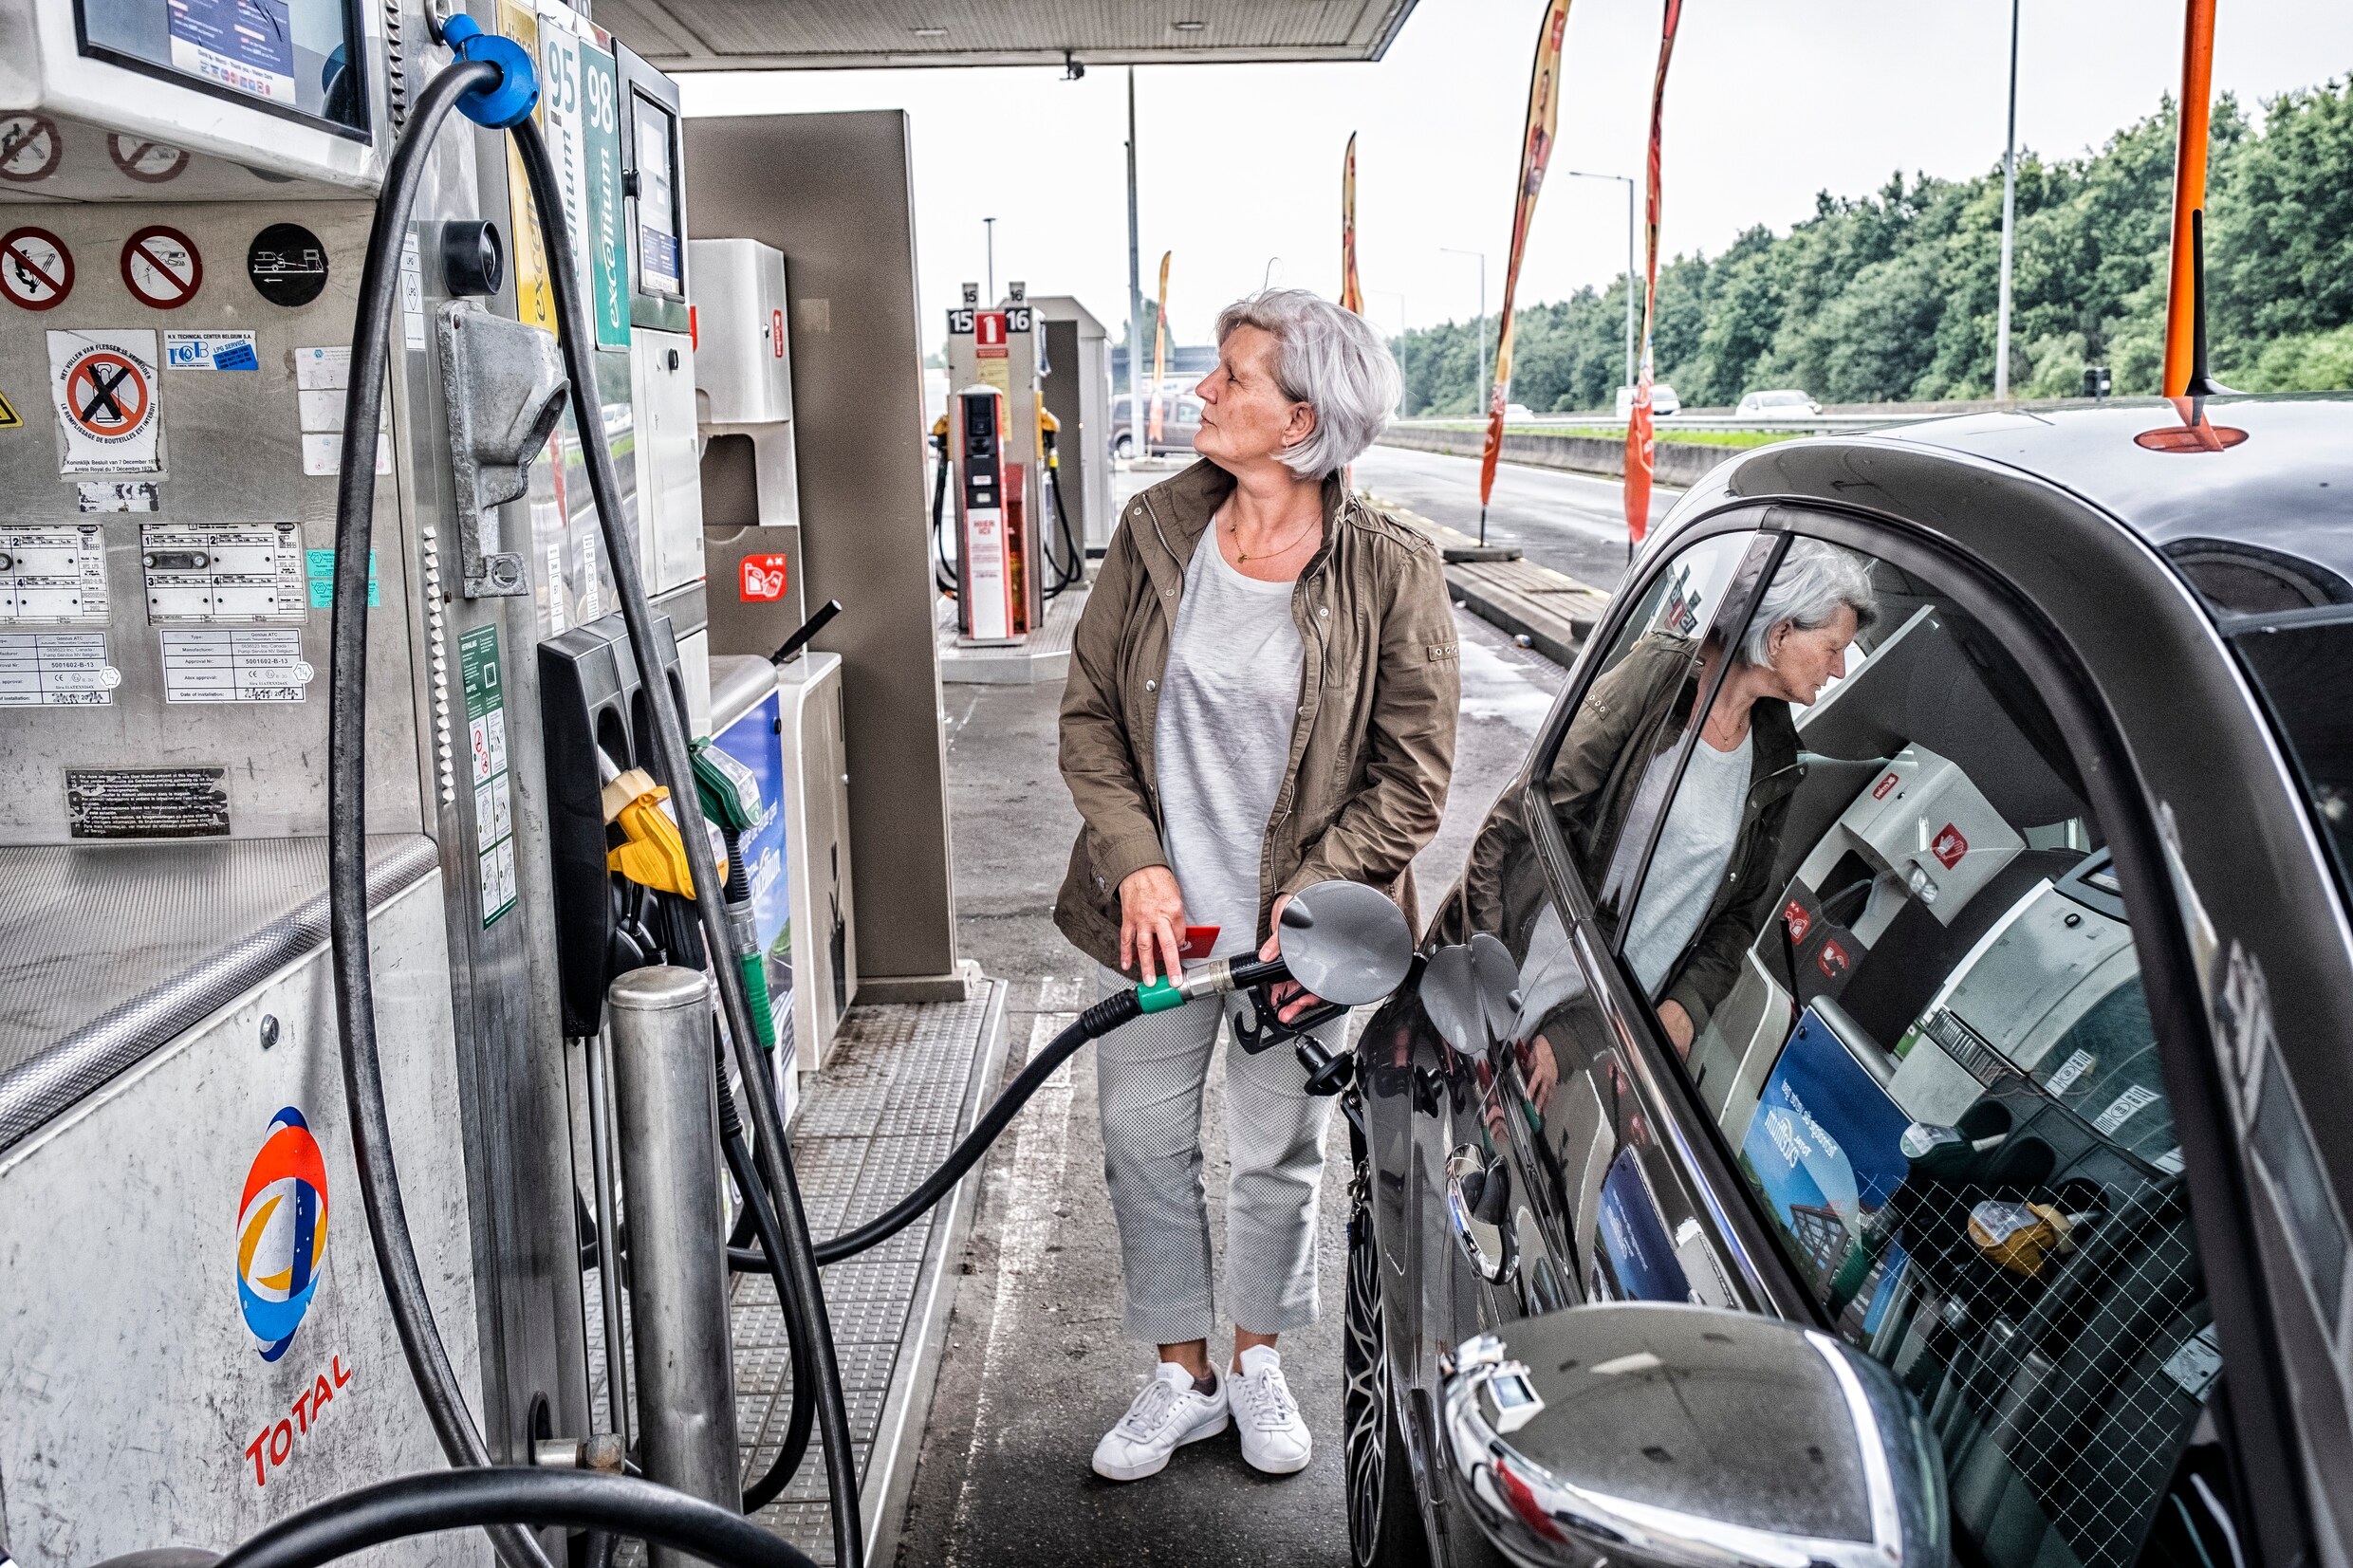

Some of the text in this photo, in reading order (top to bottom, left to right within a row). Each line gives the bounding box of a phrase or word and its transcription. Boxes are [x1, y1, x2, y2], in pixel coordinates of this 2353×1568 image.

[548, 41, 575, 113] 95
[588, 65, 614, 134] 98
[601, 148, 619, 328] excellium
[964, 290, 977, 302] 15
[1010, 290, 1023, 301] 16
[950, 311, 973, 331] 15
[1006, 310, 1029, 331] 16
[225, 339, 246, 350] SERVICE
[65, 351, 83, 371] VULLEN
[82, 346, 95, 355] VAN
[61, 403, 66, 412] LE
[64, 410, 95, 441] REMPLISSAGE
[104, 432, 137, 444] BOUTEILLES
[136, 425, 145, 436] EST
[143, 402, 156, 429] INTERDIT
[13, 538, 19, 546] 2
[210, 536, 216, 544] 2
[17, 578, 23, 587] 4
[148, 577, 154, 586] 3
[213, 577, 219, 585] 4
[245, 1354, 351, 1486] TOTAL
